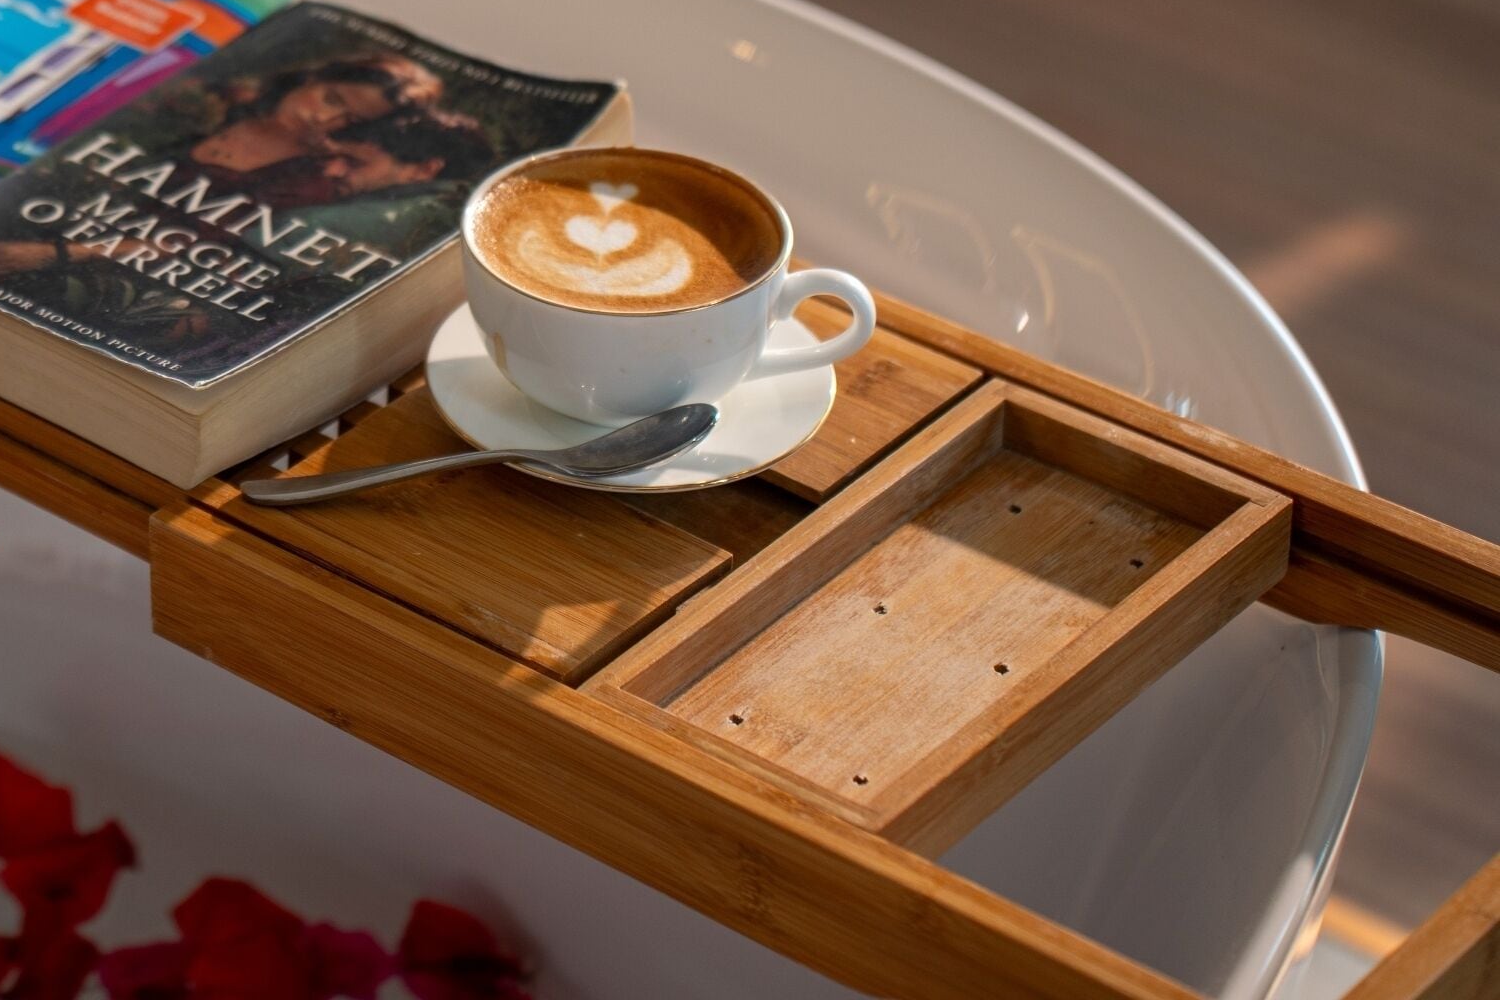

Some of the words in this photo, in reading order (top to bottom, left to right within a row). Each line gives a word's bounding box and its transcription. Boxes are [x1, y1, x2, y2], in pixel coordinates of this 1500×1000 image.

[20, 199, 275, 322] O'FARRELL
[64, 131, 401, 282] HAMNET
[77, 192, 280, 290] MAGGIE
[35, 308, 106, 341] MOTION
[108, 337, 183, 372] PICTURE
